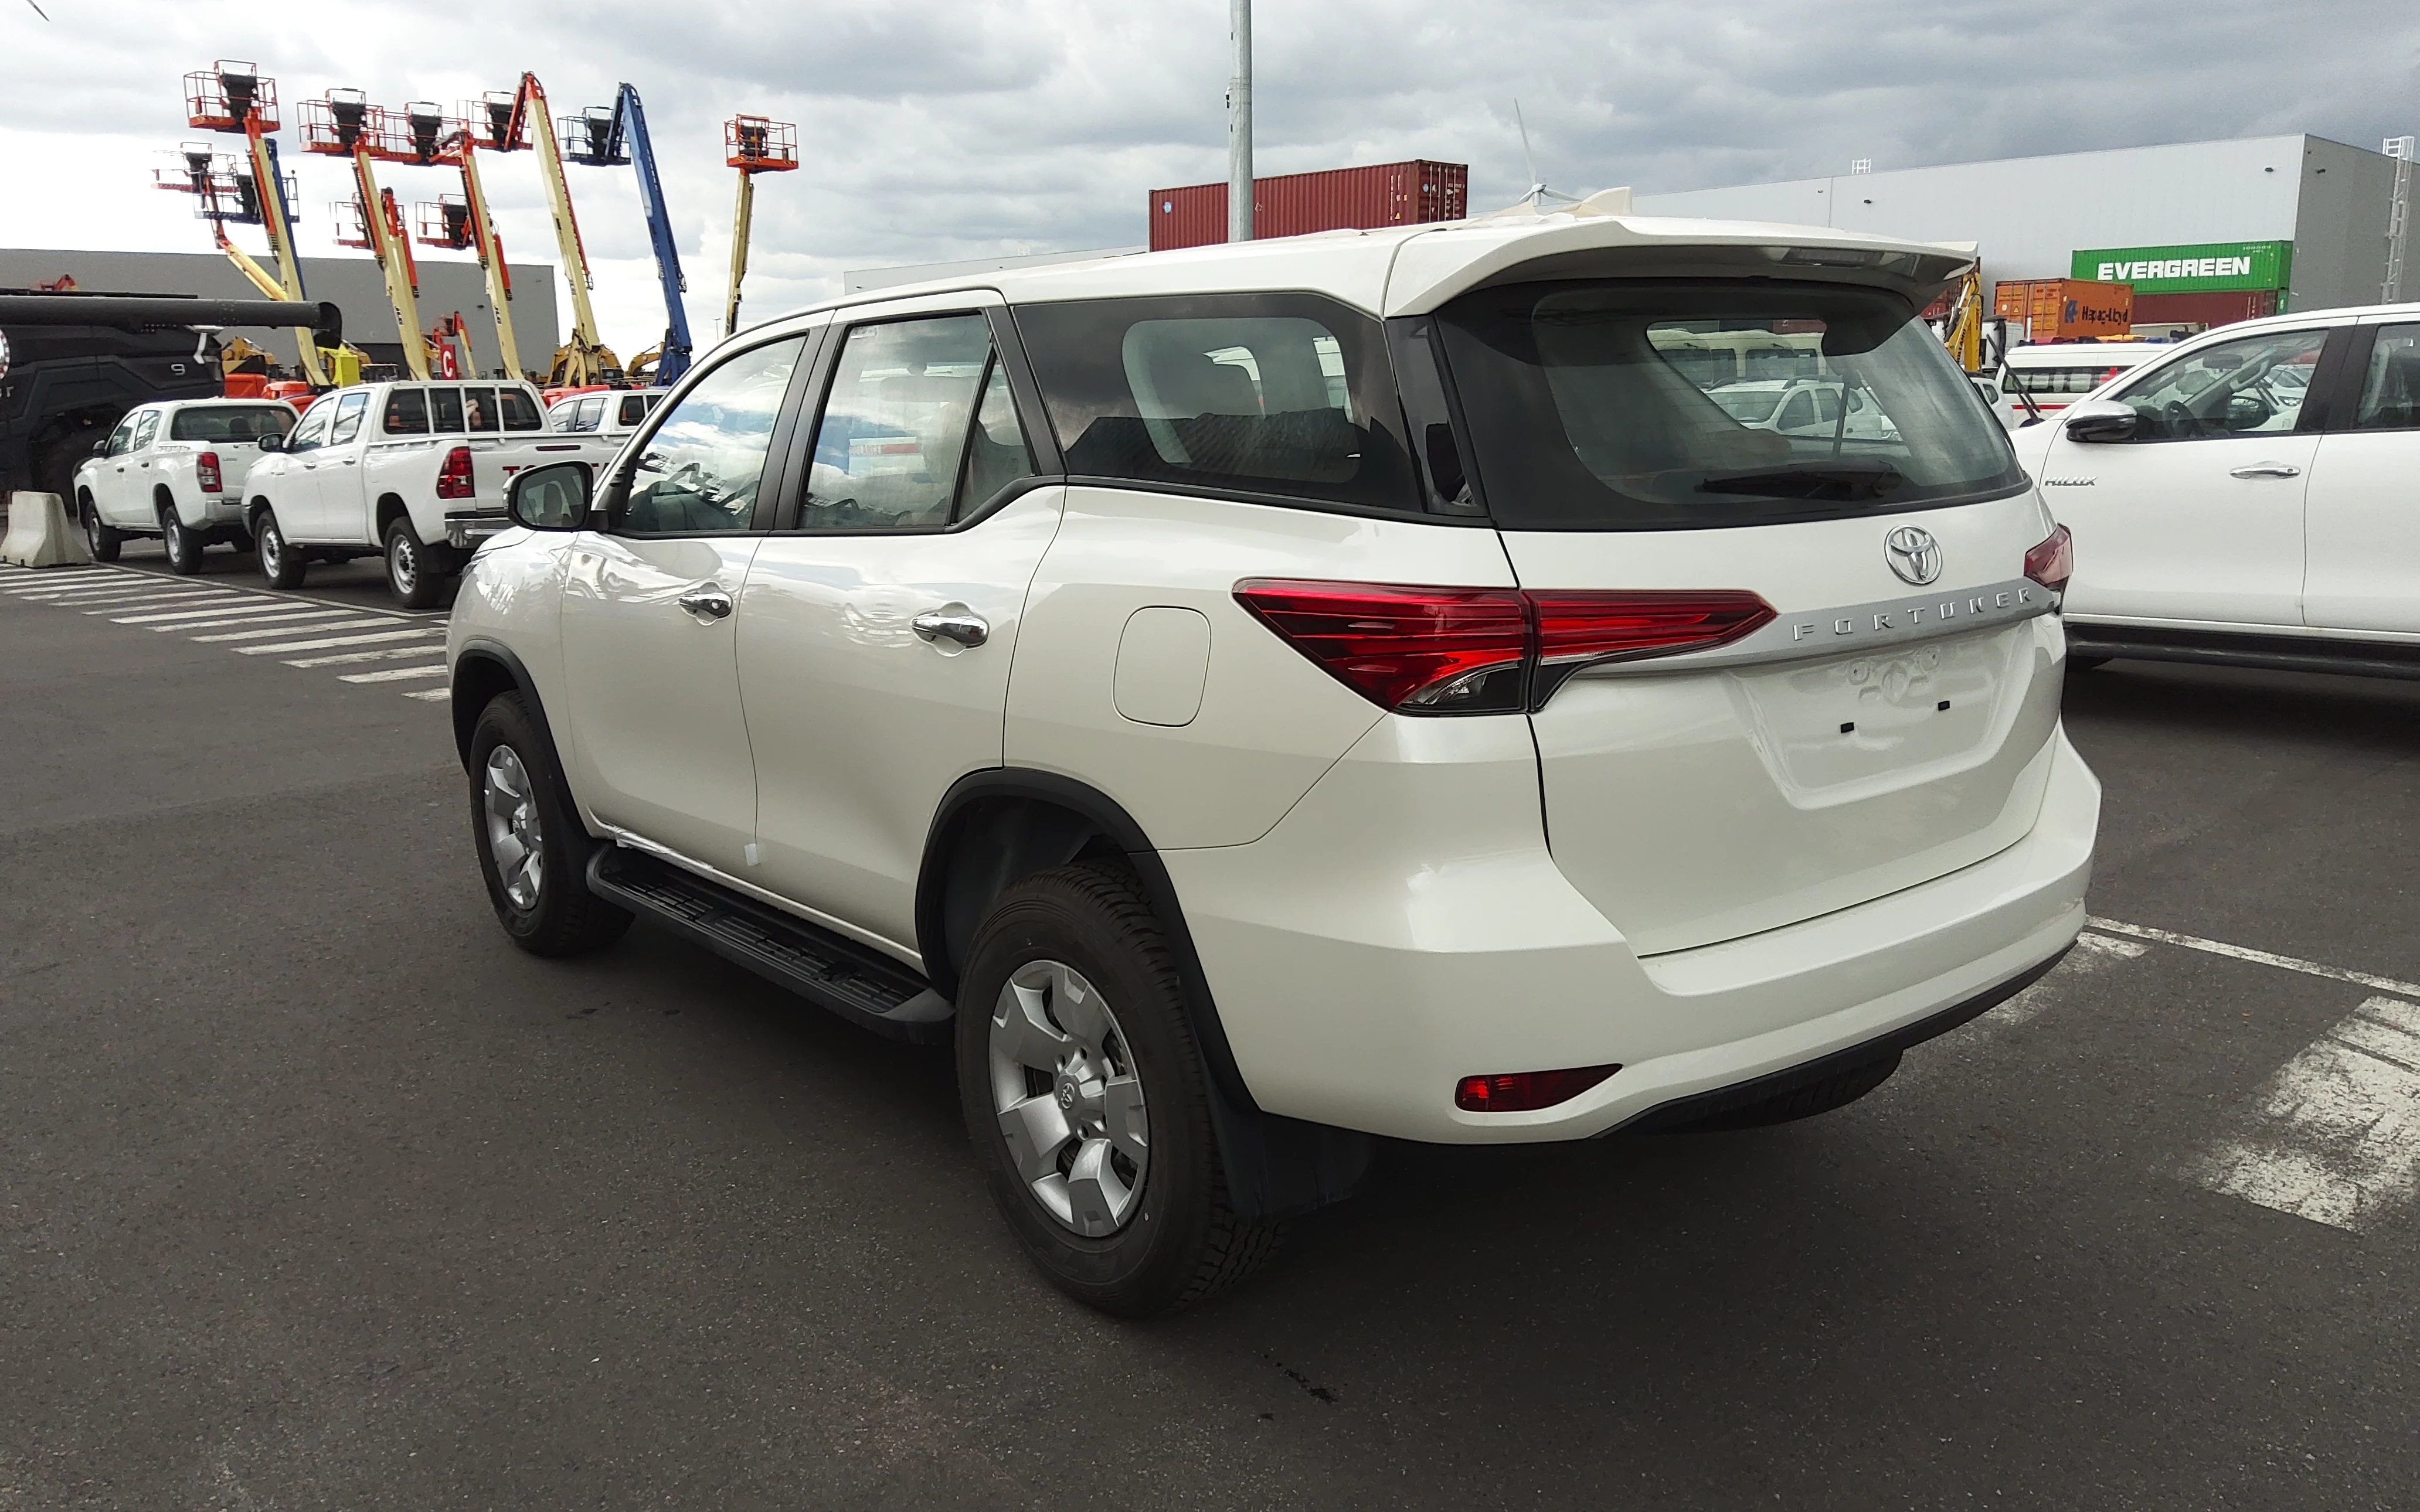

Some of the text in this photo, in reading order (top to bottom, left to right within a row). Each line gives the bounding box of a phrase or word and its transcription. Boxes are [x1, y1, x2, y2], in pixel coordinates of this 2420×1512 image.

[2098, 256, 2251, 281] EVERGREEN
[443, 350, 453, 377] C
[2044, 476, 2098, 486] HILUX
[1792, 587, 2030, 641] FORTUNER
